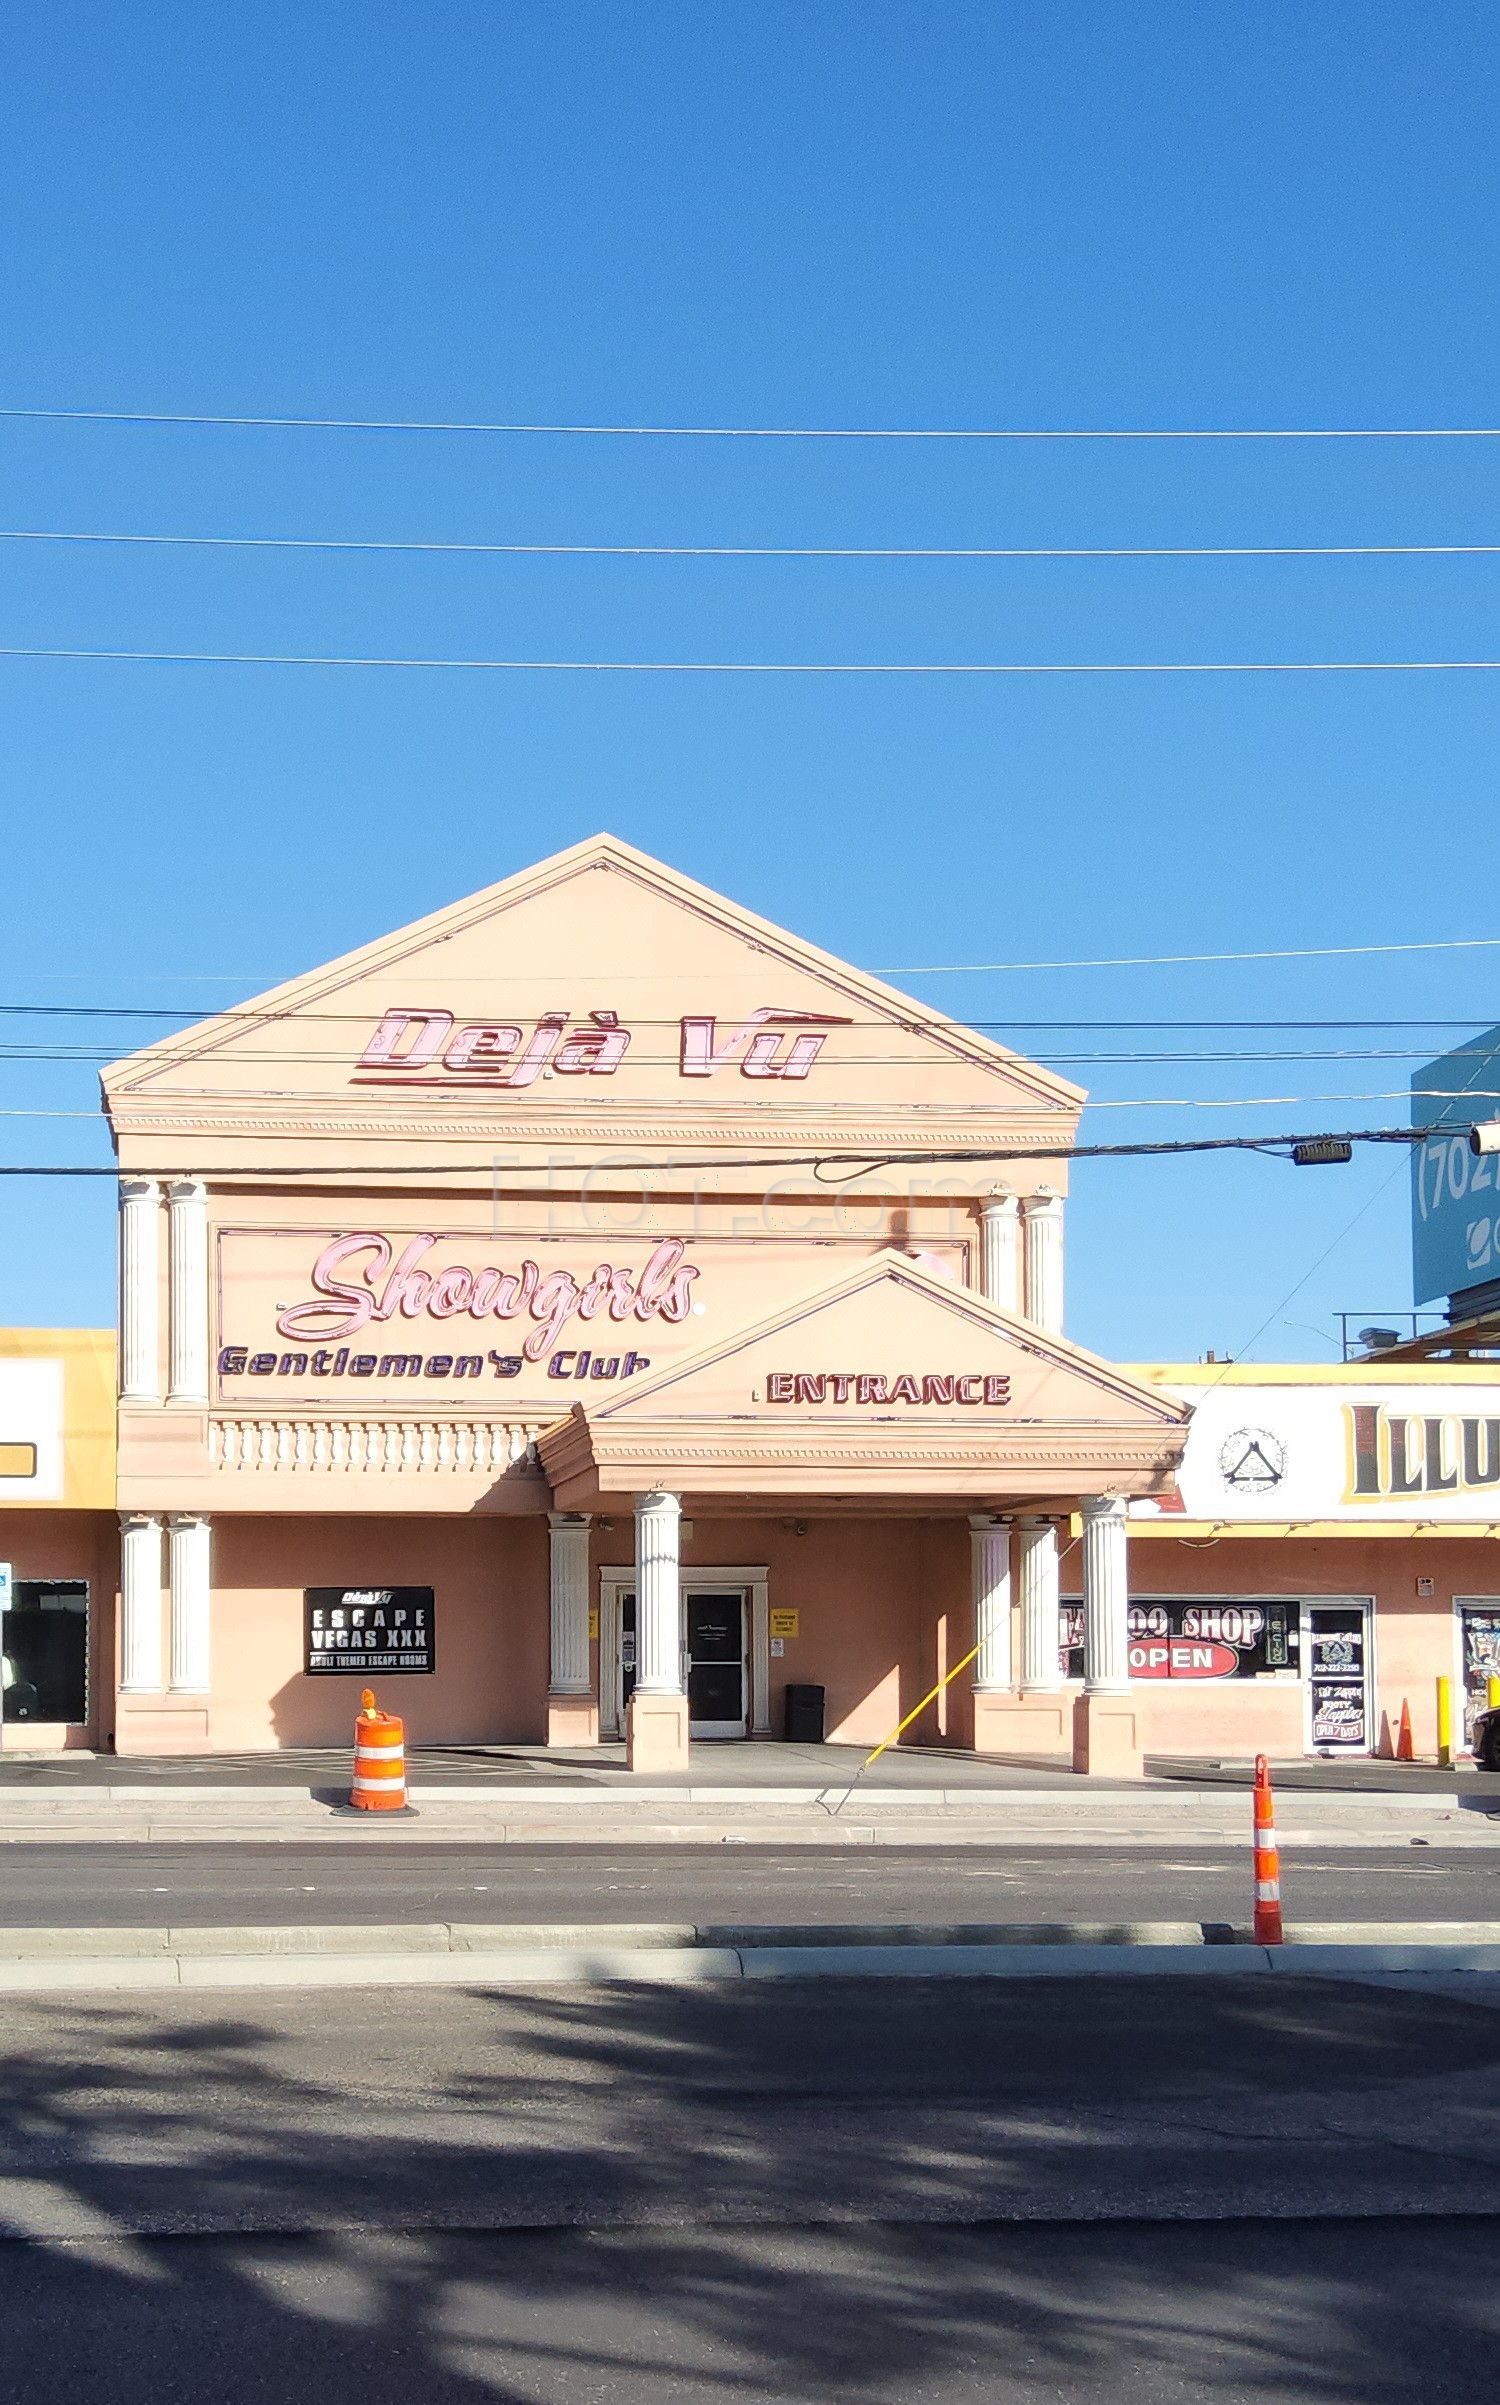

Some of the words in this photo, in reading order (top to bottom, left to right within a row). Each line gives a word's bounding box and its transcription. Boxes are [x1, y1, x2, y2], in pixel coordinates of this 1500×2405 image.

[680, 1007, 854, 1079] Vu
[277, 1231, 702, 1362] Showgirls
[217, 1346, 525, 1379] Gentlemen's
[547, 1350, 651, 1380] Club
[766, 1373, 1012, 1406] ENTRANCE
[313, 1609, 425, 1628] ESCAPE
[1183, 1606, 1262, 1645] SHOP
[311, 1630, 377, 1648] VEGAS
[387, 1630, 426, 1647] XXX
[310, 1655, 334, 1667] ADULT
[336, 1655, 366, 1666] THEMED
[368, 1655, 397, 1666] ESCAPE
[1129, 1648, 1212, 1668] OPEN
[1316, 1724, 1334, 1736] OPEN
[1333, 1726, 1341, 1736] 7
[1340, 1726, 1360, 1738] DAYS
